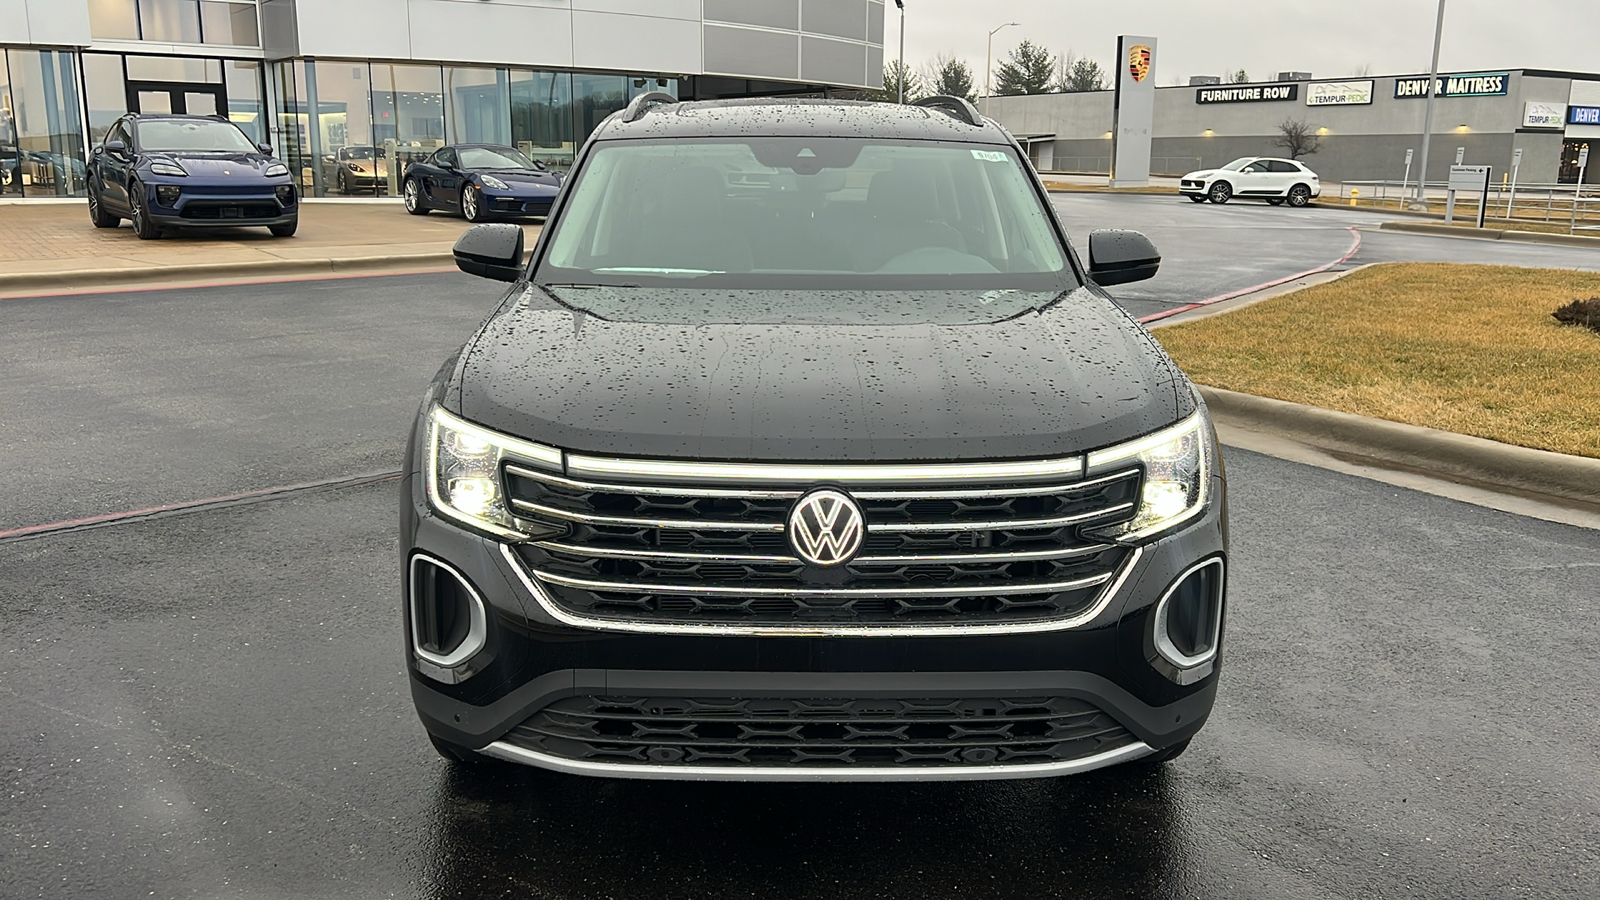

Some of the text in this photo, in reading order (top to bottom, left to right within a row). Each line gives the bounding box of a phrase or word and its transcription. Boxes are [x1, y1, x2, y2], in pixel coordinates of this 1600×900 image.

[1201, 87, 1290, 102] FURNITURE ROW
[1397, 76, 1502, 96] DENVR MATTRESS
[1575, 108, 1600, 122] DENVER
[791, 492, 862, 564] VW
